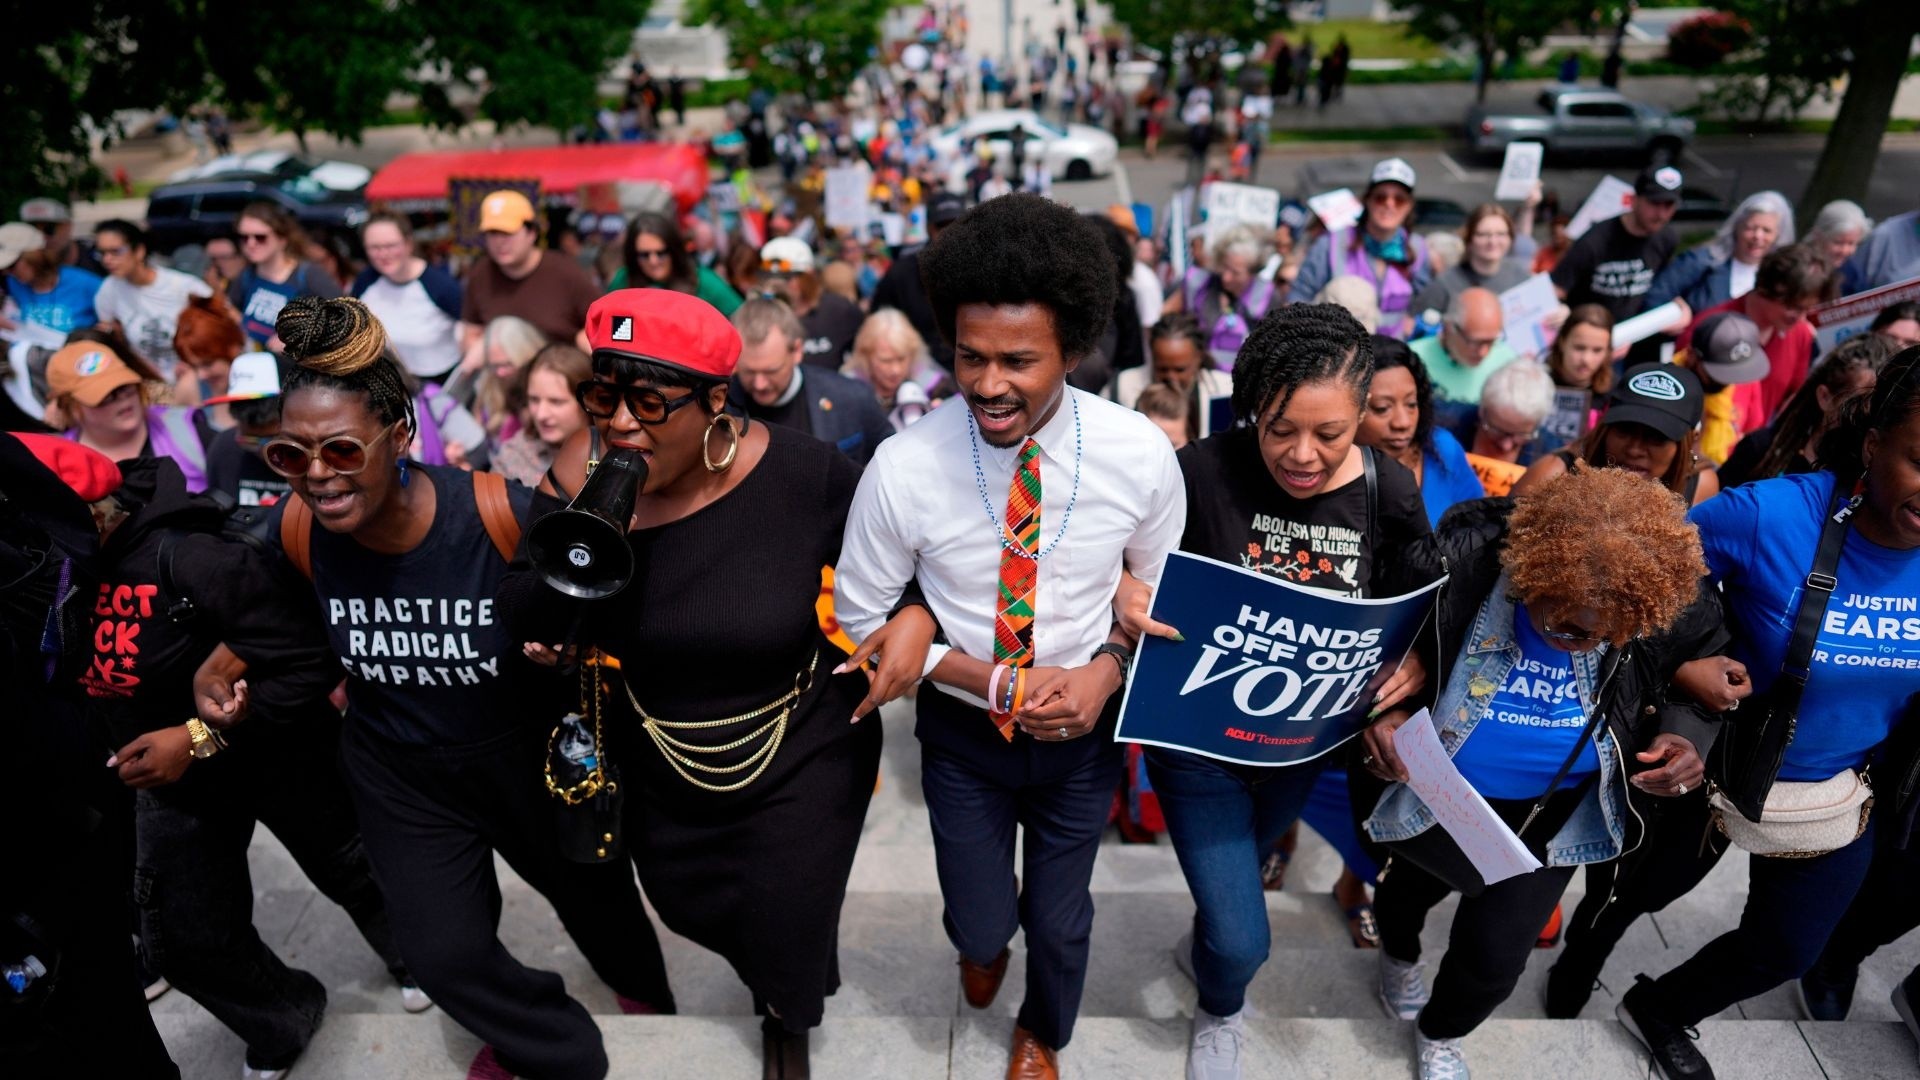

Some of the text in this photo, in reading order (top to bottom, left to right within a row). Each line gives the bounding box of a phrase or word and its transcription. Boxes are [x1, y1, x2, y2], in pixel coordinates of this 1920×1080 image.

[1251, 513, 1309, 540] ABOLISH
[1310, 525, 1362, 543] NO HUMAN
[1264, 533, 1292, 554] ICE
[1311, 539, 1361, 556] IS ILLEGAL
[95, 583, 158, 618] ECT
[329, 597, 493, 627] PRACTICE
[1843, 594, 1917, 612] JUSTIN
[1236, 604, 1383, 649] HANDS
[1823, 609, 1920, 641] EARS
[349, 629, 480, 660] RADICAL
[1213, 624, 1383, 671] OFF OUR
[1878, 644, 1897, 654] for
[340, 655, 499, 687] EMPATHY
[1515, 658, 1568, 680] USTIN
[1833, 653, 1920, 670] CONGRE
[1179, 644, 1383, 722] VOTE
[1531, 703, 1547, 714] for
[1224, 727, 1315, 746] ACLU Tennessee
